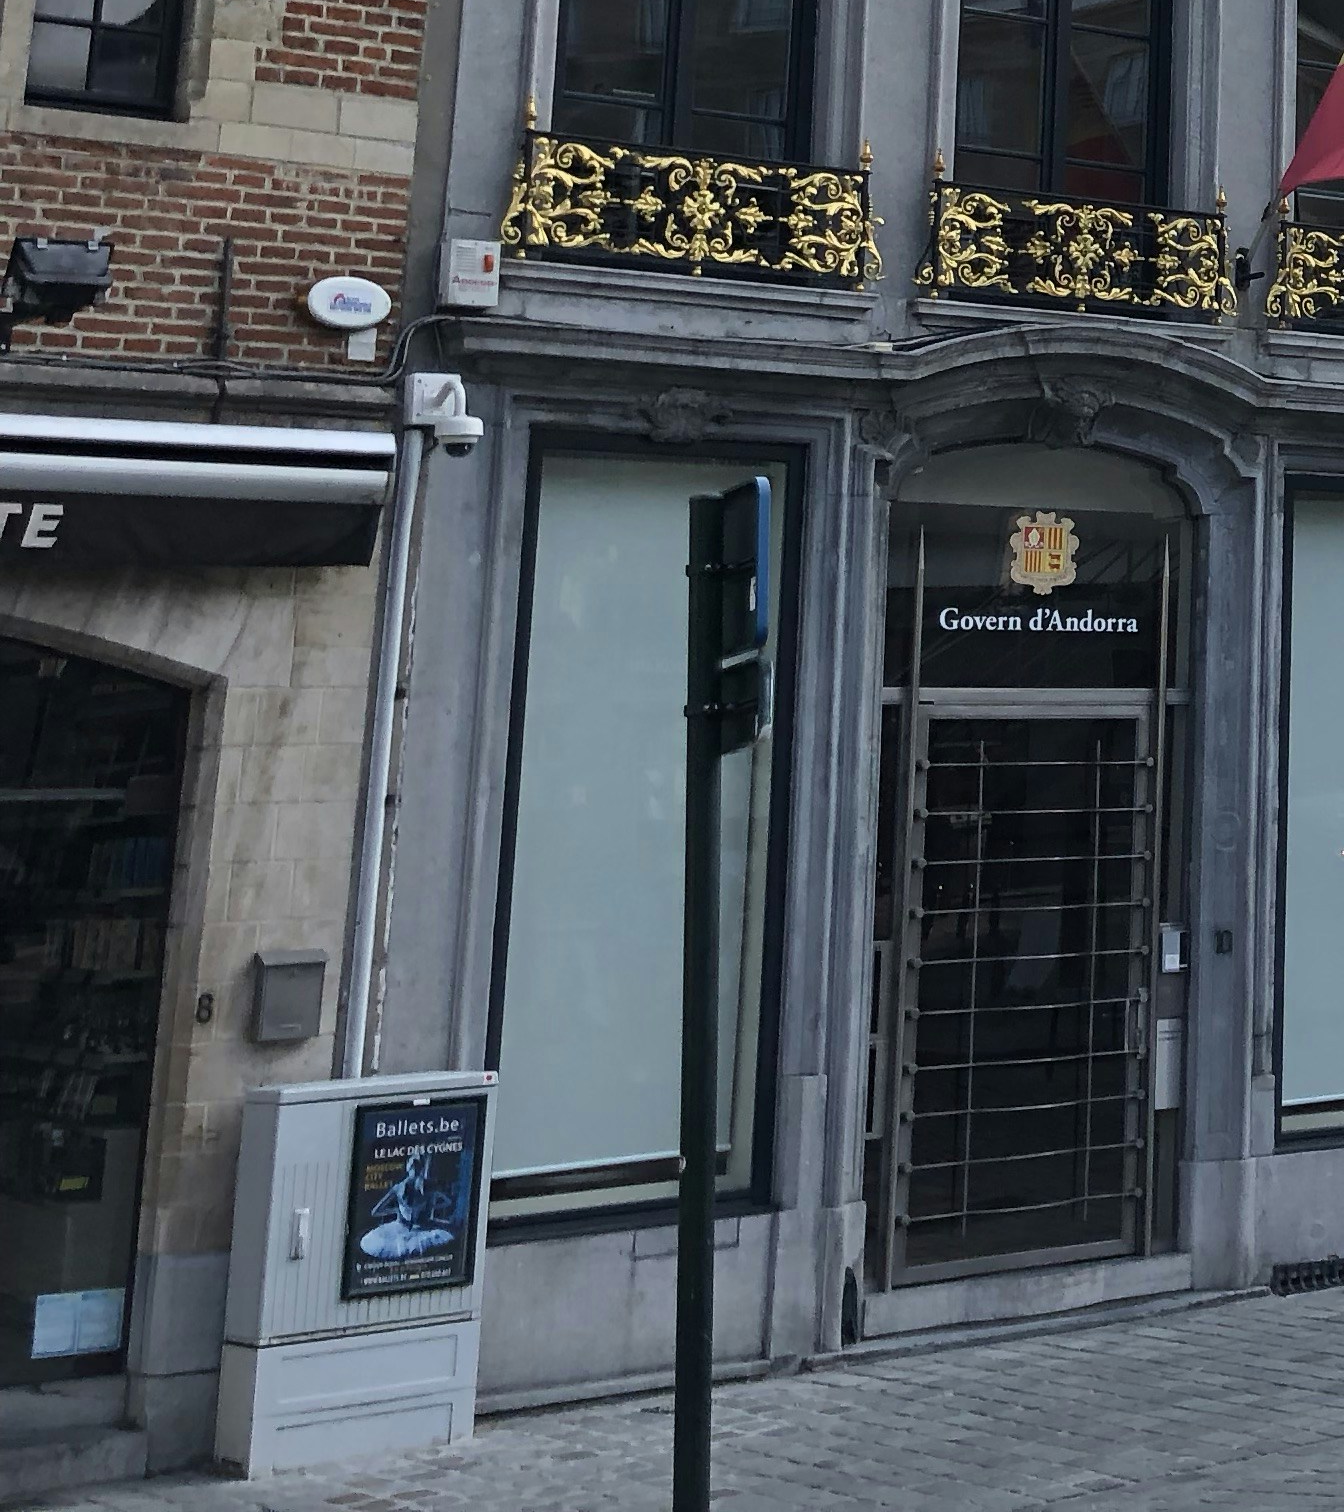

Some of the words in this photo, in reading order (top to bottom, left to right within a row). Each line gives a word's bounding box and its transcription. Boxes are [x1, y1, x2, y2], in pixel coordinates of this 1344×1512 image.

[939, 608, 1022, 632] Govern
[1028, 609, 1138, 633] d'Andorra
[196, 993, 214, 1024] 8
[376, 1117, 460, 1138] Ballets.be
[375, 1148, 386, 1159] LE
[387, 1146, 405, 1158] LAC
